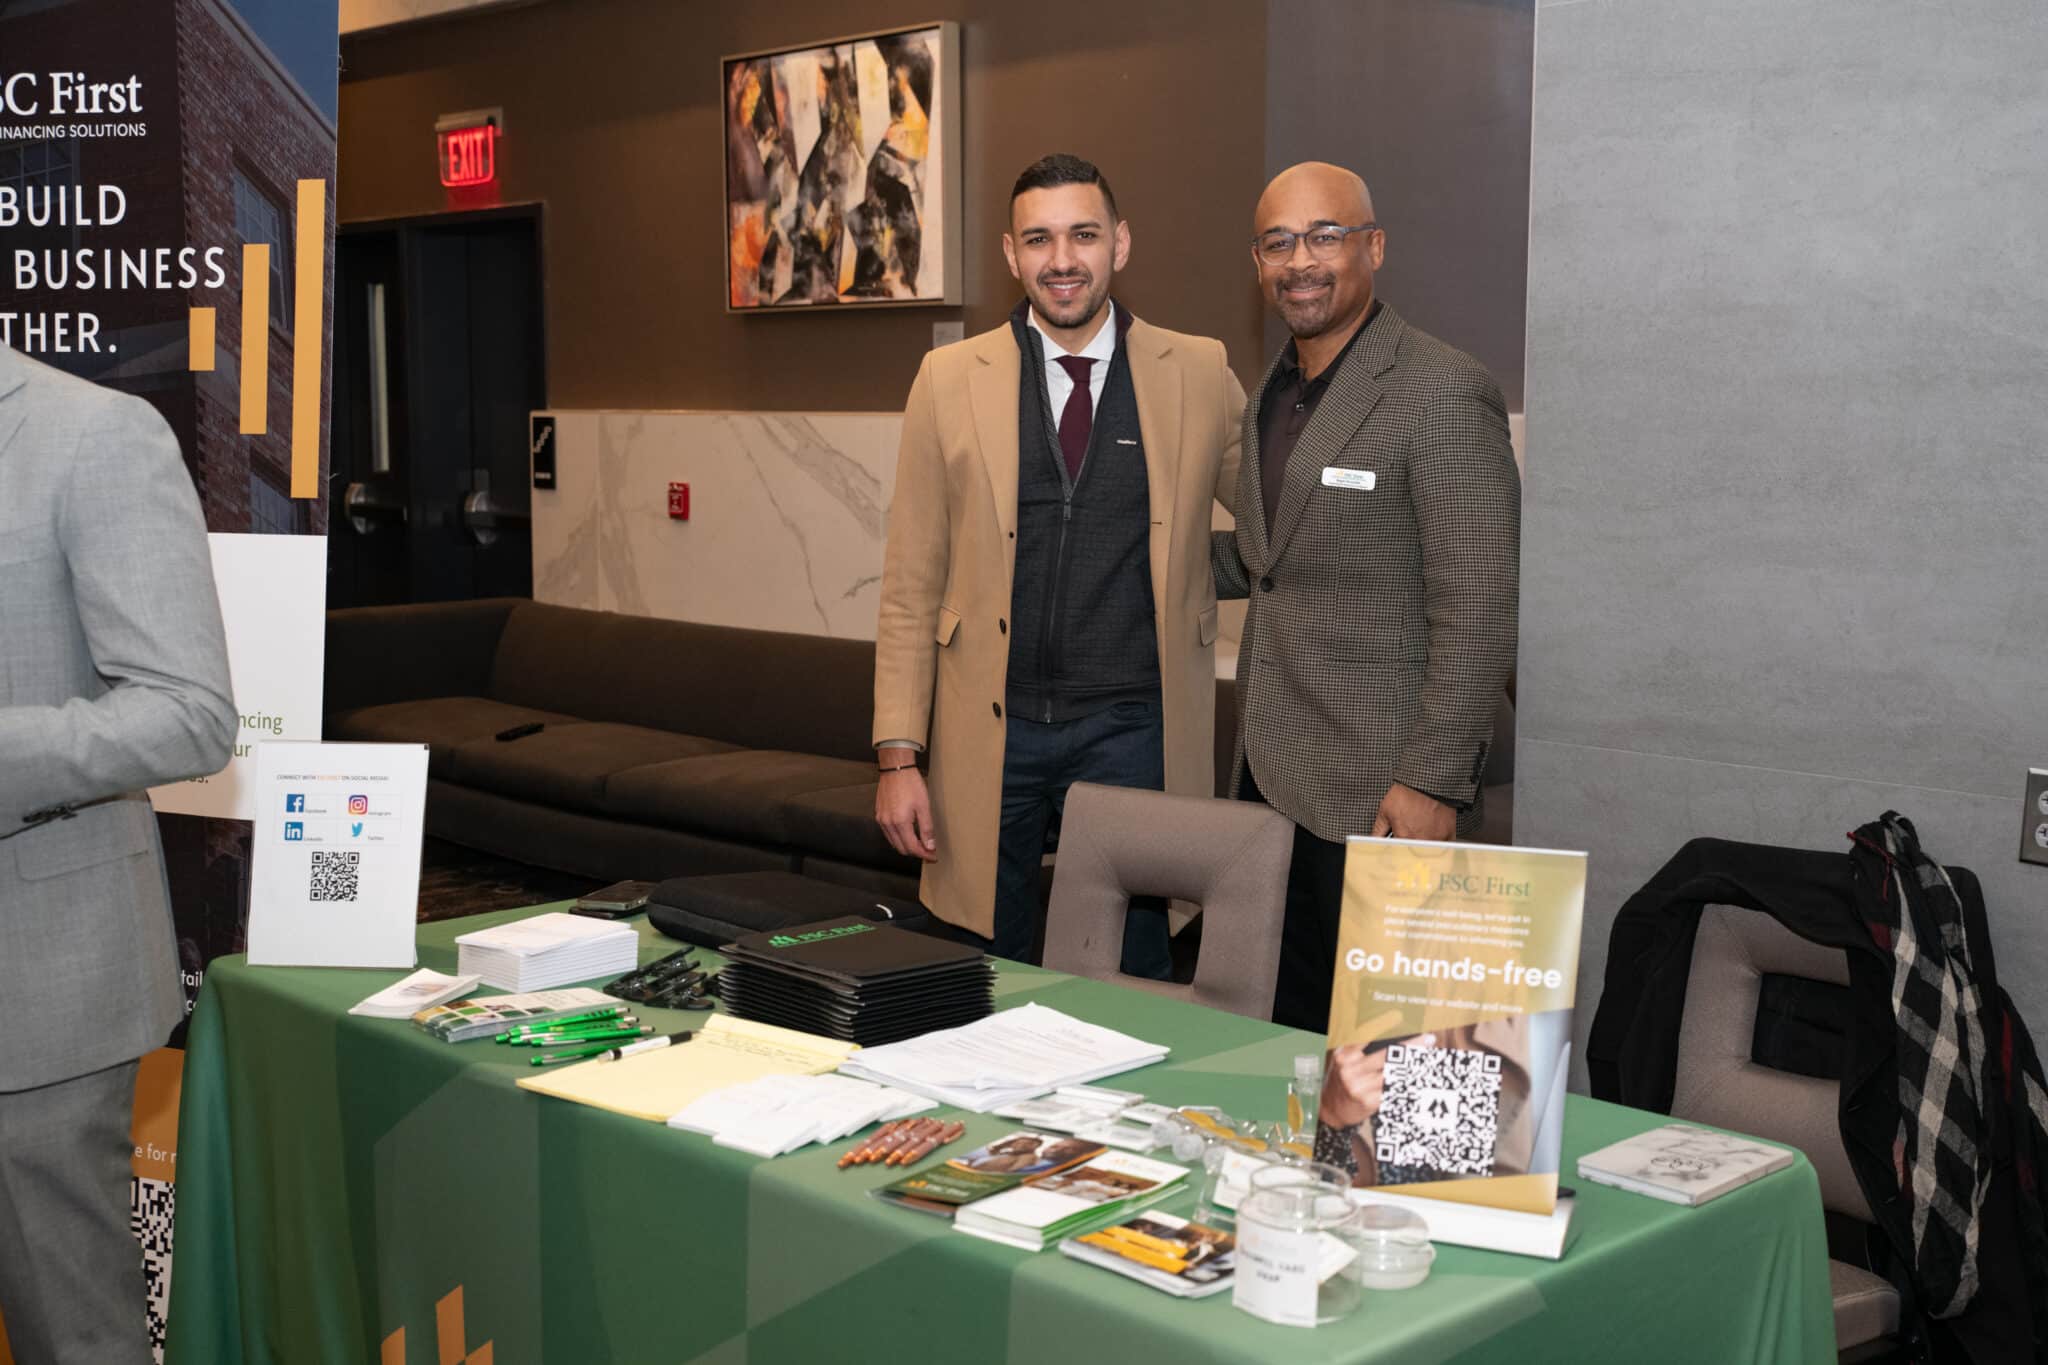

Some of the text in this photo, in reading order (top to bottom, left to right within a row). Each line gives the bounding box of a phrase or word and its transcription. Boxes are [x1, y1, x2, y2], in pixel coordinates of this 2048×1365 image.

[0, 72, 143, 115] C First
[69, 123, 146, 137] SOLUTIONS
[448, 133, 484, 180] EXIT
[0, 185, 126, 226] BUILD
[15, 247, 226, 289] BUSINESS
[0, 312, 117, 353] THER.
[1439, 872, 1530, 897] FSC First
[1345, 948, 1563, 989] Go hands-free
[147, 1143, 167, 1162] for
